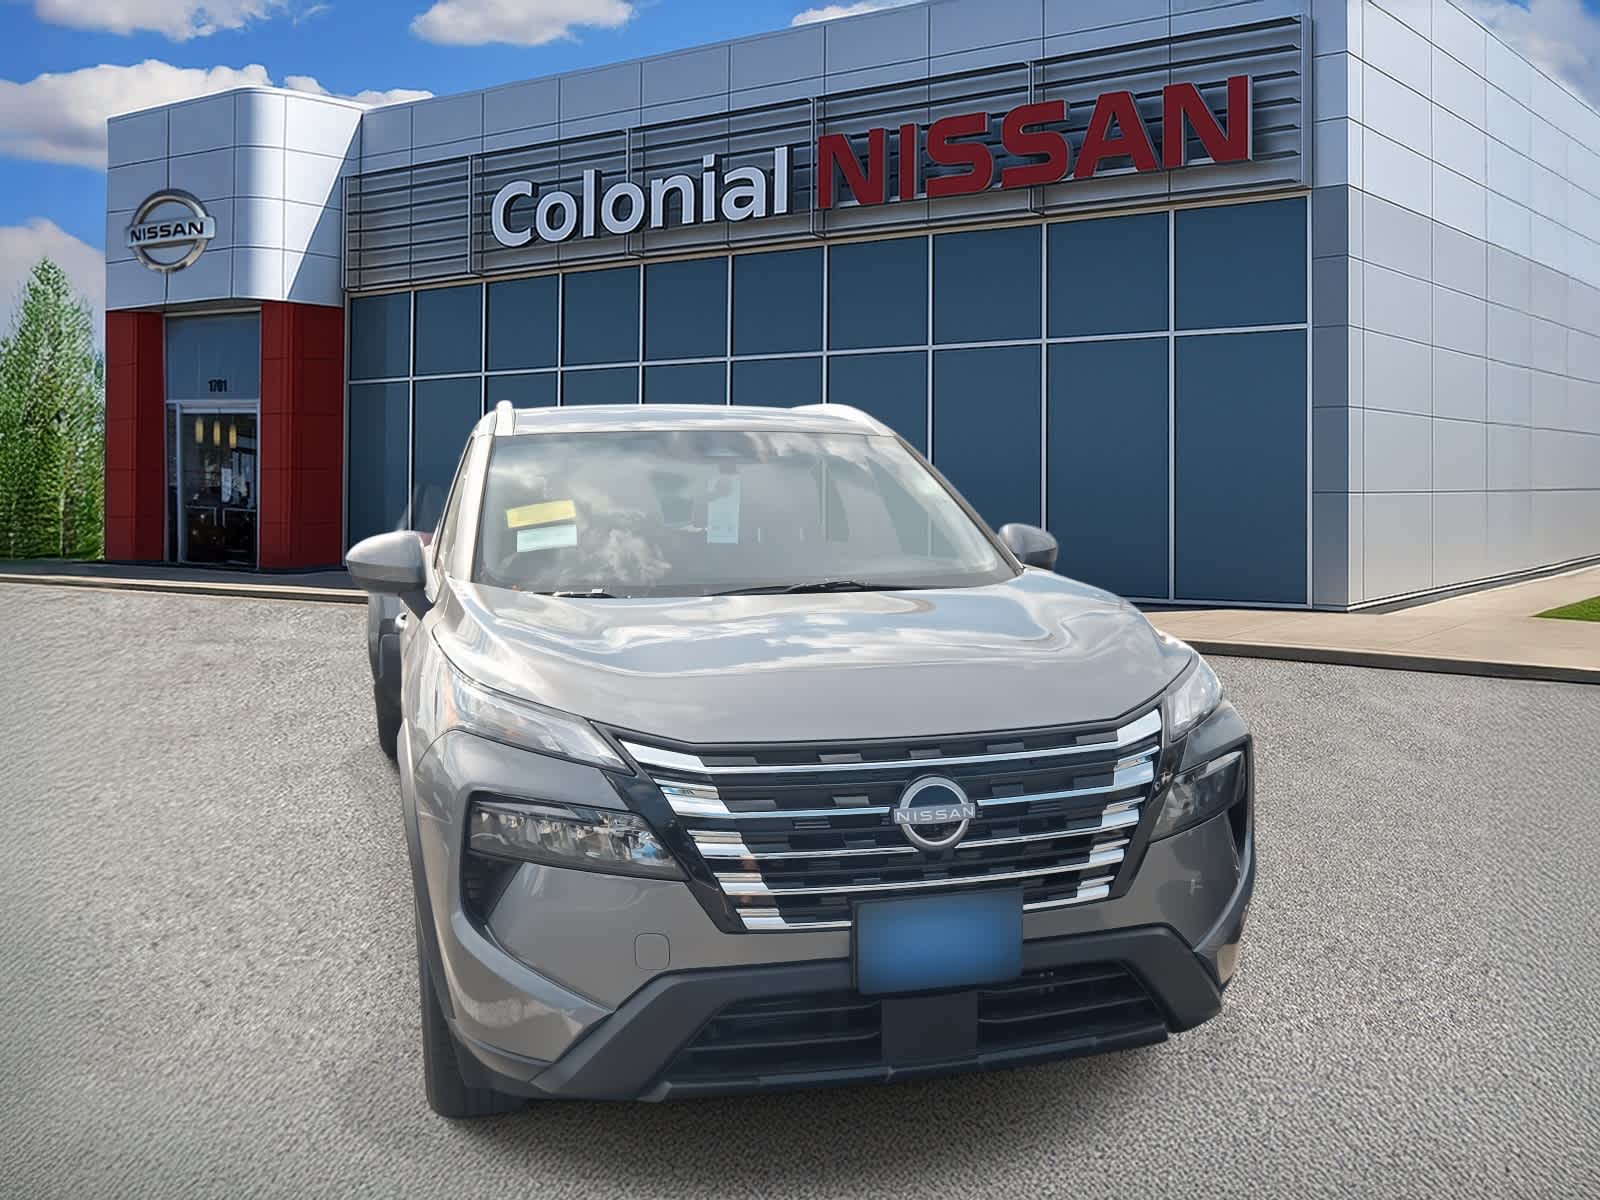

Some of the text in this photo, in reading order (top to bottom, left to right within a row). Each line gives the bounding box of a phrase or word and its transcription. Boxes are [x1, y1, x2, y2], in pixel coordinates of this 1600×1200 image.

[491, 75, 1253, 247] Colonial NISSAN
[130, 221, 205, 243] NISSAN
[896, 806, 975, 822] NISSAN
